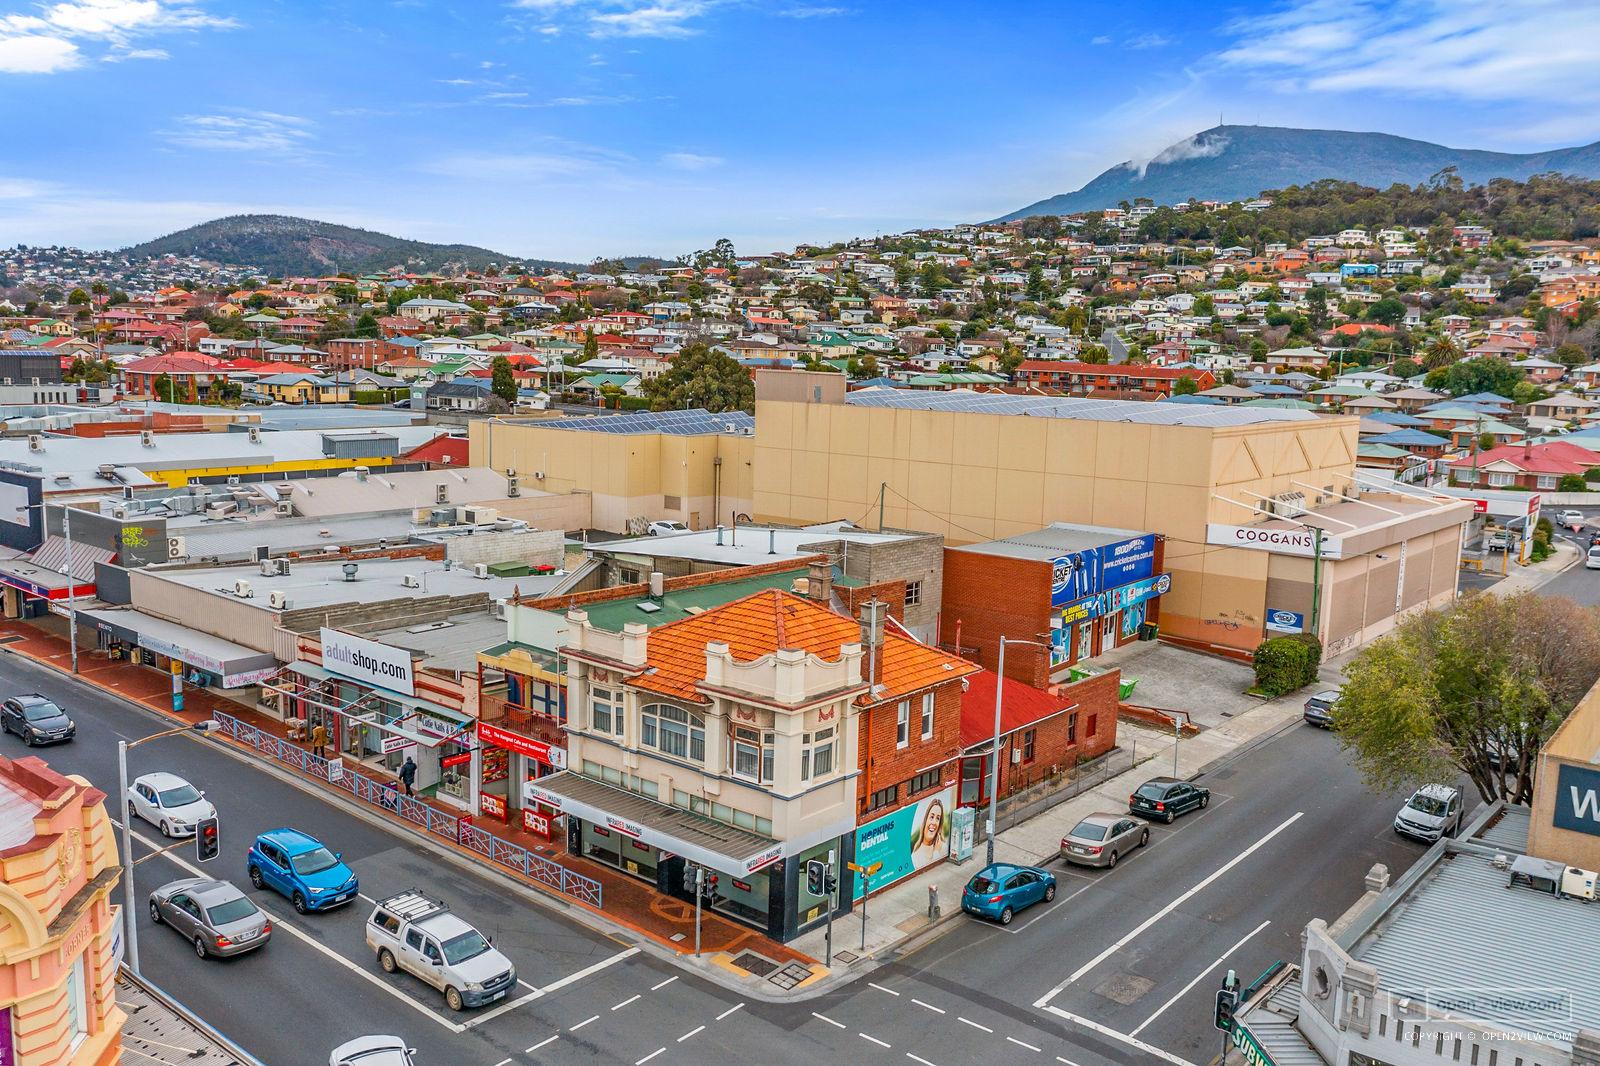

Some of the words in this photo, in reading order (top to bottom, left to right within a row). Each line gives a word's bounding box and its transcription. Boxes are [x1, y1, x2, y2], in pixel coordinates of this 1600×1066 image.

[1236, 529, 1311, 547] COOGANS
[1053, 565, 1073, 580] ICKET
[326, 642, 406, 680] adultshop.com
[861, 820, 895, 842] HOPKINS
[861, 832, 888, 851] DENTAL
